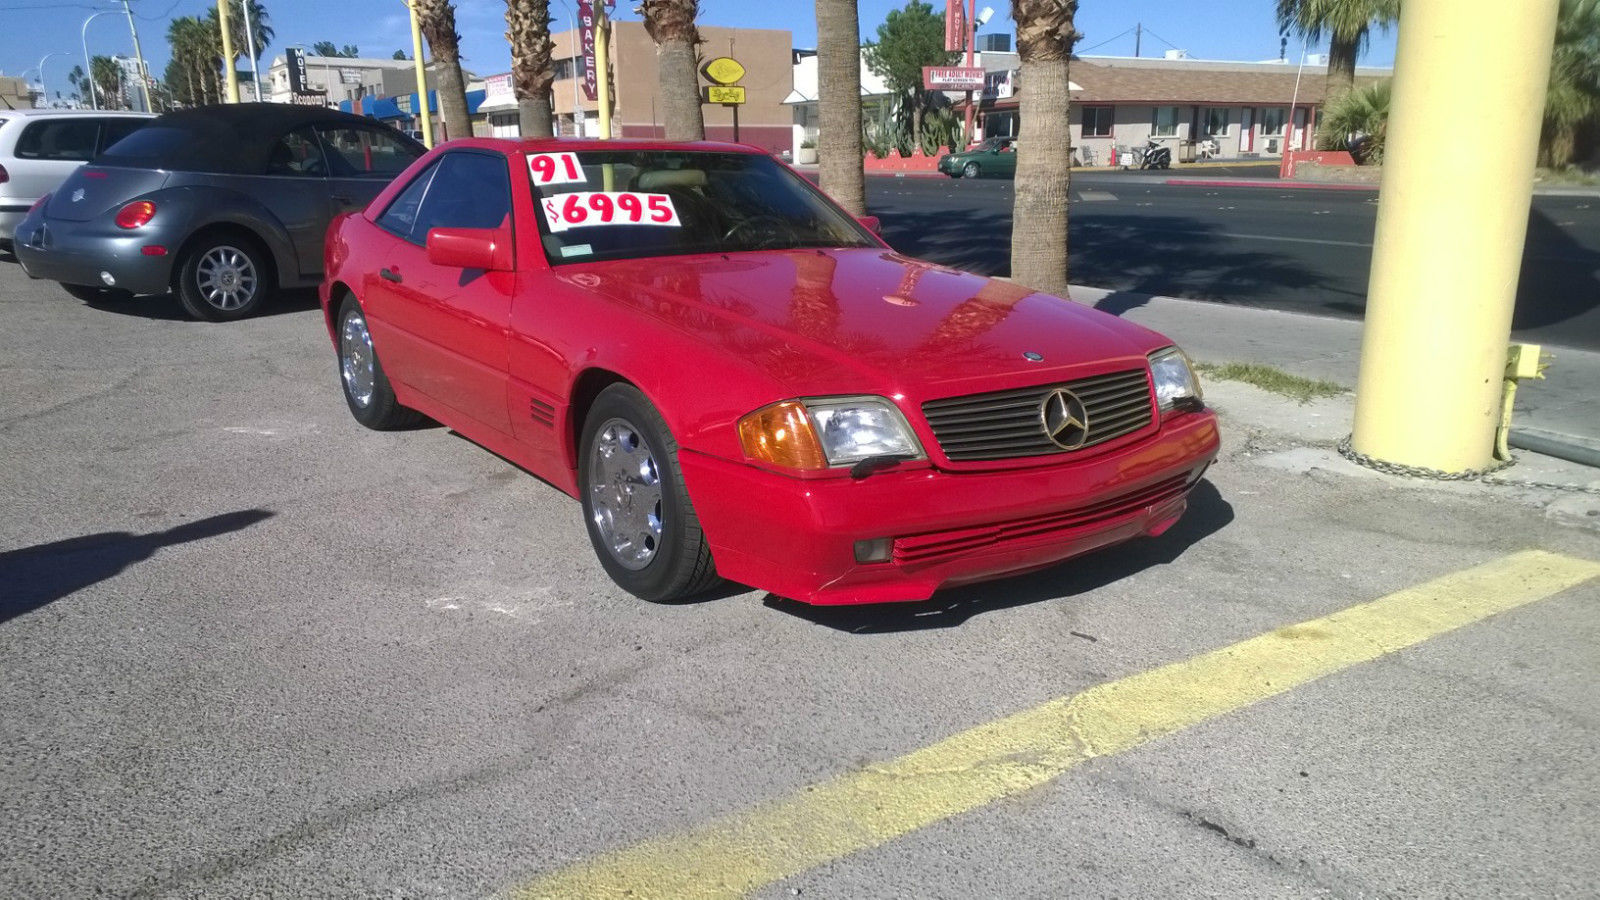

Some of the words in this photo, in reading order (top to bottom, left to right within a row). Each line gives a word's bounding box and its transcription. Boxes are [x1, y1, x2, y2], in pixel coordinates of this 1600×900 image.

[295, 48, 307, 92] MOTEL
[583, 16, 595, 94] BAKERY
[531, 155, 578, 182] 91
